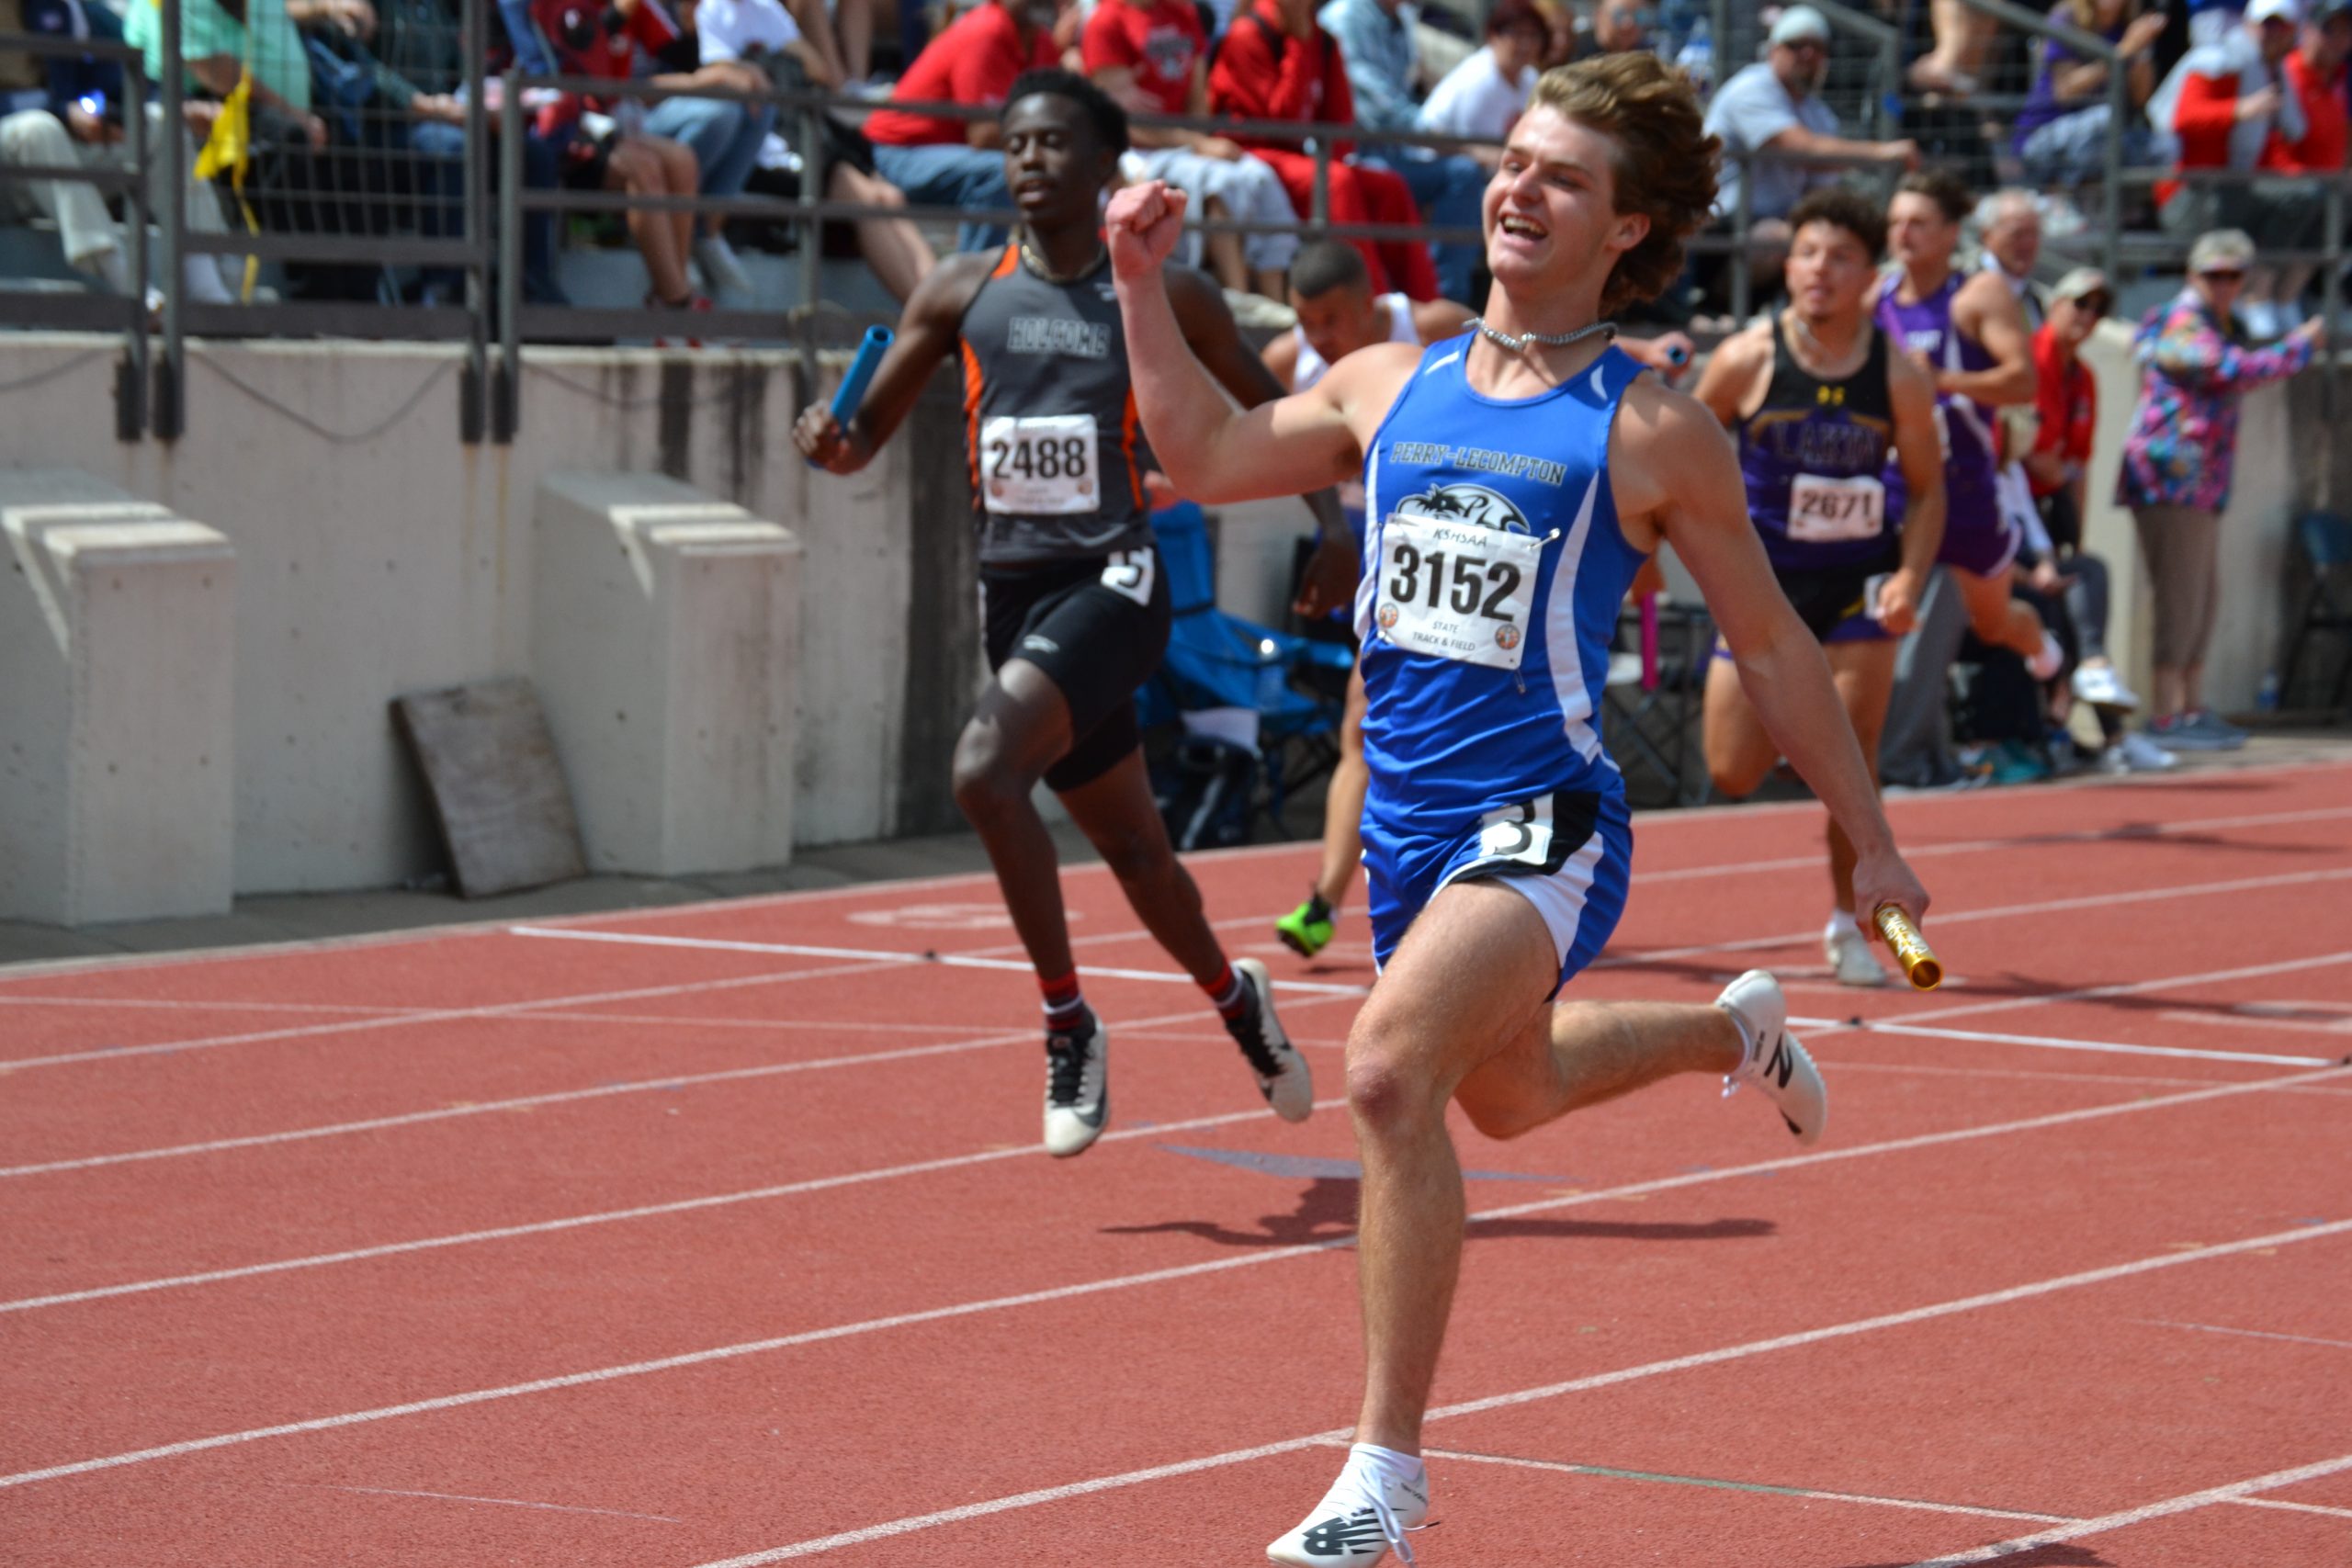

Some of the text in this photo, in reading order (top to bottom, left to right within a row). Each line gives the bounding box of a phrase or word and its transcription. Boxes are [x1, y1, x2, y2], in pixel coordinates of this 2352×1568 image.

[991, 435, 1087, 479] 2488
[1391, 443, 1566, 485] PERRY-LECOMPTON
[1800, 489, 1873, 520] 2671
[1432, 527, 1488, 547] KSHSAA
[1390, 544, 1521, 622] 3152
[1412, 630, 1476, 652] TRACK & FIELD
[1432, 621, 1460, 635] STATE
[1494, 797, 1536, 856] 3
